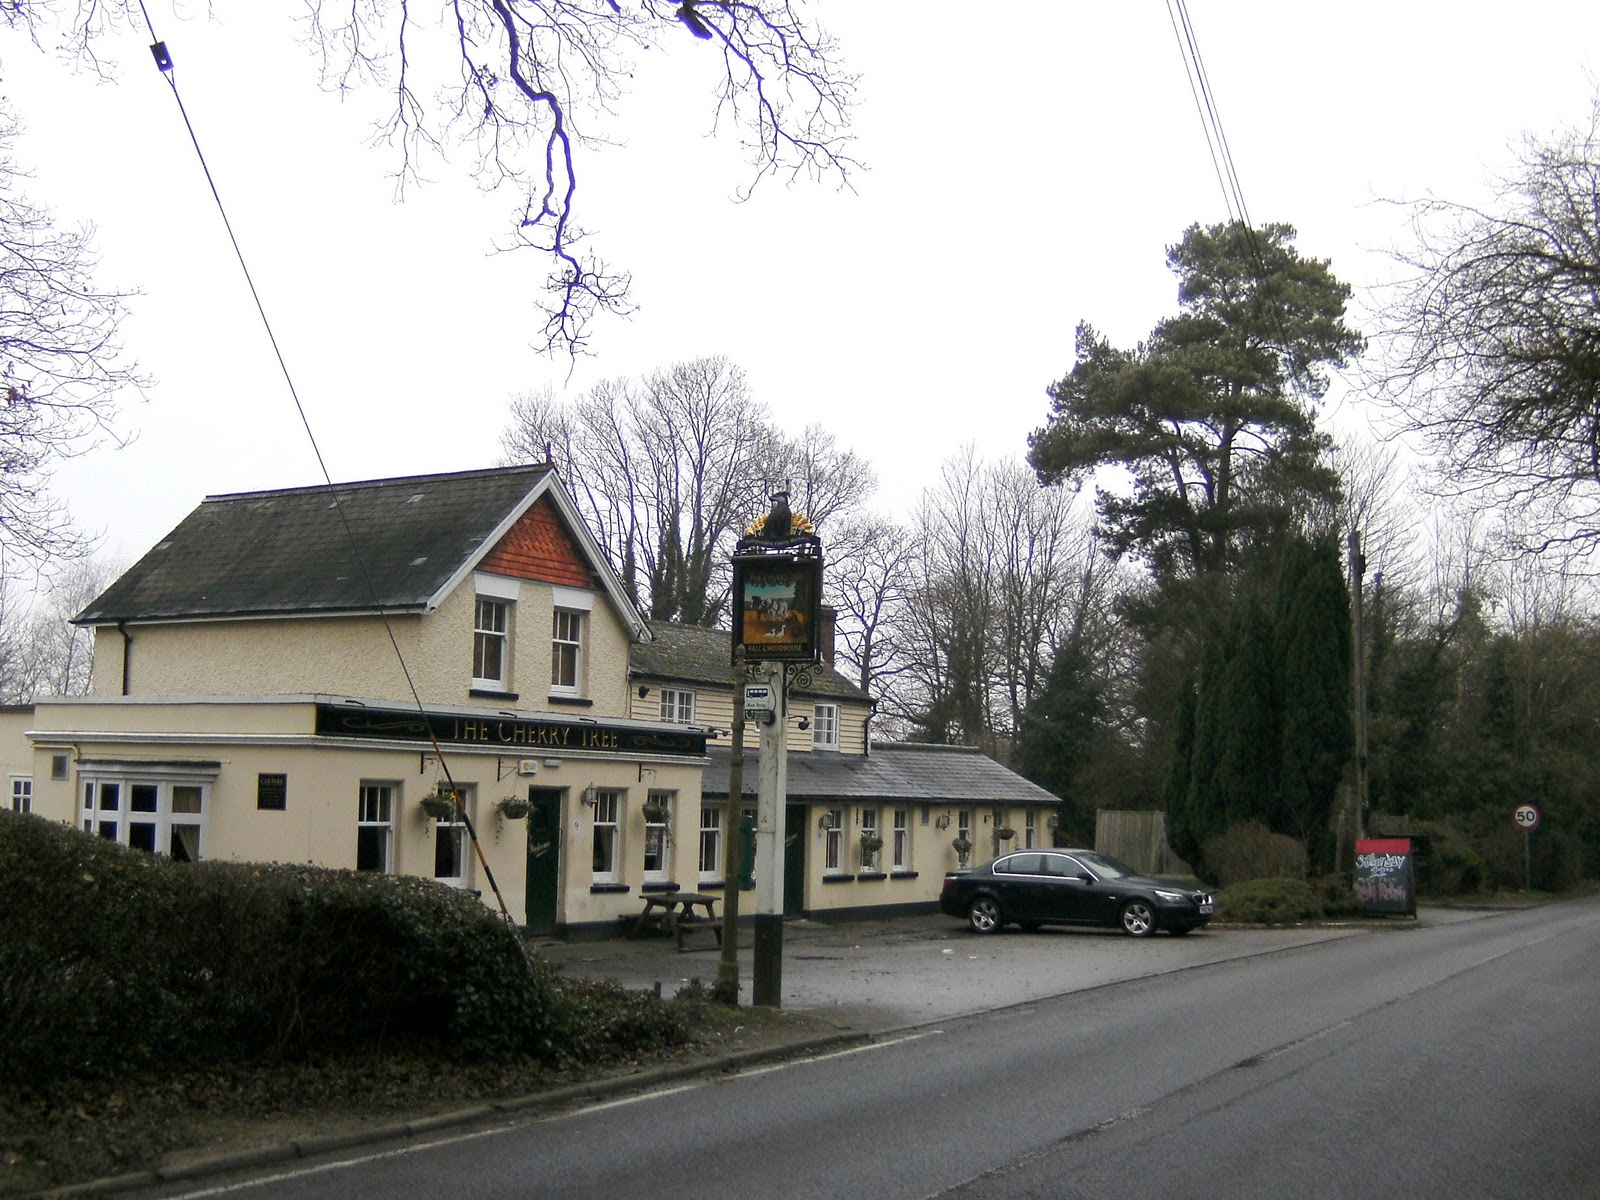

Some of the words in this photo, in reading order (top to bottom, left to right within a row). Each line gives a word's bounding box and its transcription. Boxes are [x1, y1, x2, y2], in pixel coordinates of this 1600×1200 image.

[767, 644, 802, 652] WOODHOUSE
[454, 719, 488, 741] THE
[498, 722, 570, 745] CHERRY
[583, 728, 618, 748] TREE
[1517, 810, 1535, 822] 50
[1355, 853, 1405, 869] Saturday
